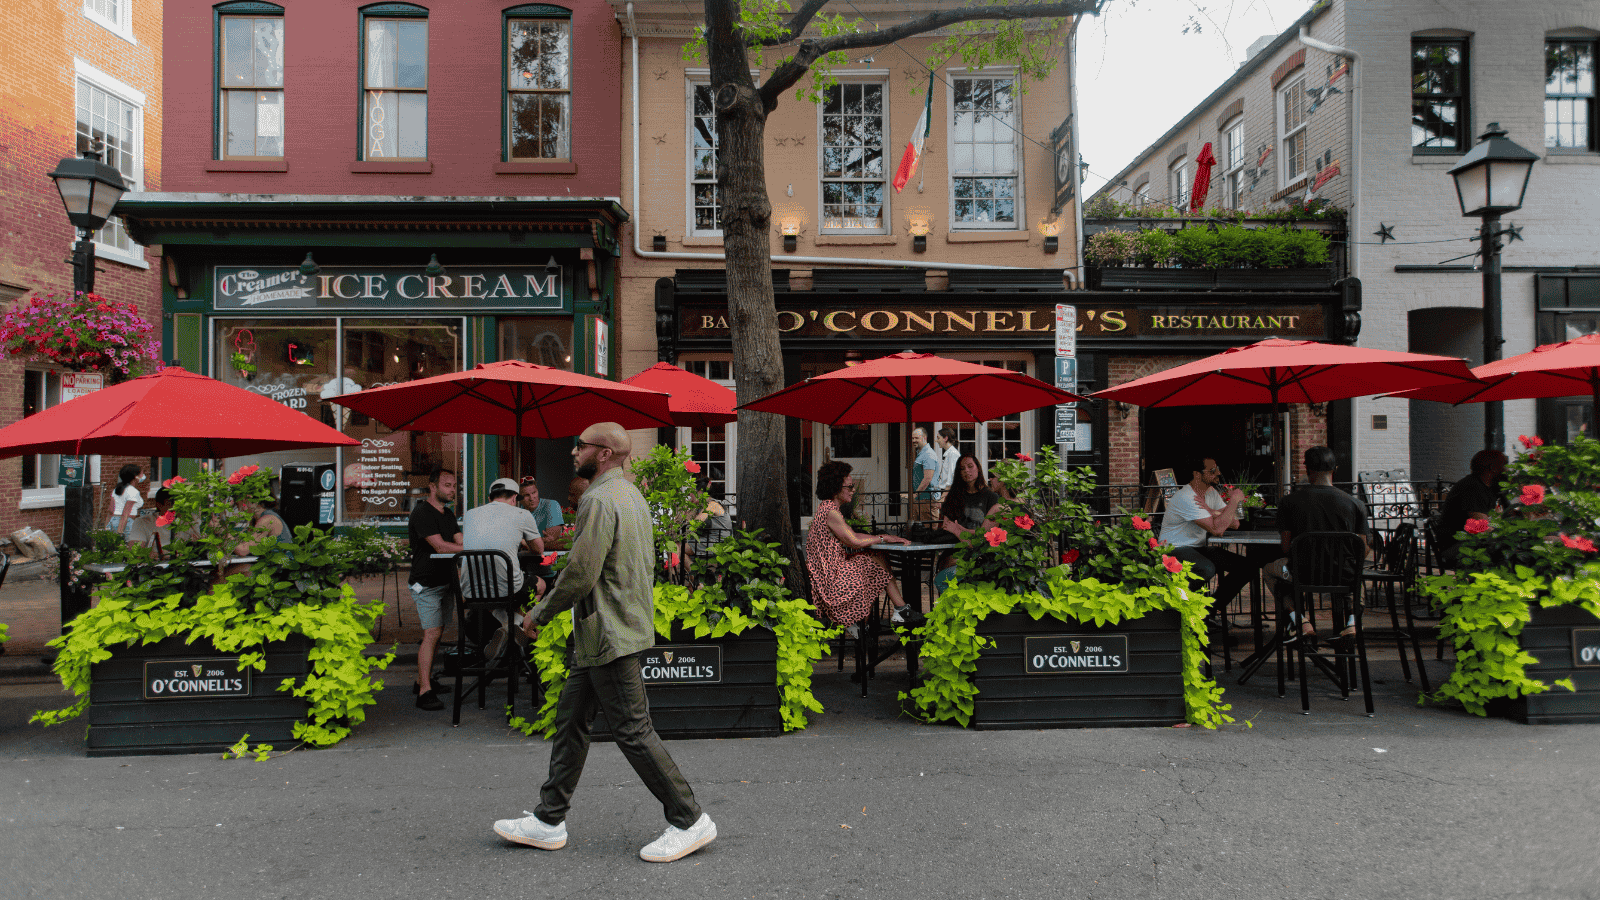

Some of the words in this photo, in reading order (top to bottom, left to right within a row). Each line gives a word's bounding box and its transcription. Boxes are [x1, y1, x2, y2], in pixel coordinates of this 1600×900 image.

[370, 90, 385, 157] YOGA
[240, 269, 258, 279] The
[316, 273, 390, 300] ICE
[396, 273, 559, 300] CREAM
[252, 289, 300, 302] HOMEMADE
[1150, 315, 1300, 330] RESTAURANT
[1062, 360, 1069, 375] P
[63, 375, 75, 387] NO
[75, 377, 101, 385] PARKING
[272, 388, 307, 401] FROZEN
[326, 472, 333, 488] P
[370, 488, 388, 496] Sugar
[677, 656, 696, 664] 2006
[1032, 654, 1121, 669] O'CONNELL'S
[174, 670, 189, 678] EST.
[206, 669, 225, 677] 2006
[151, 678, 243, 694] O'CONNELL'S
